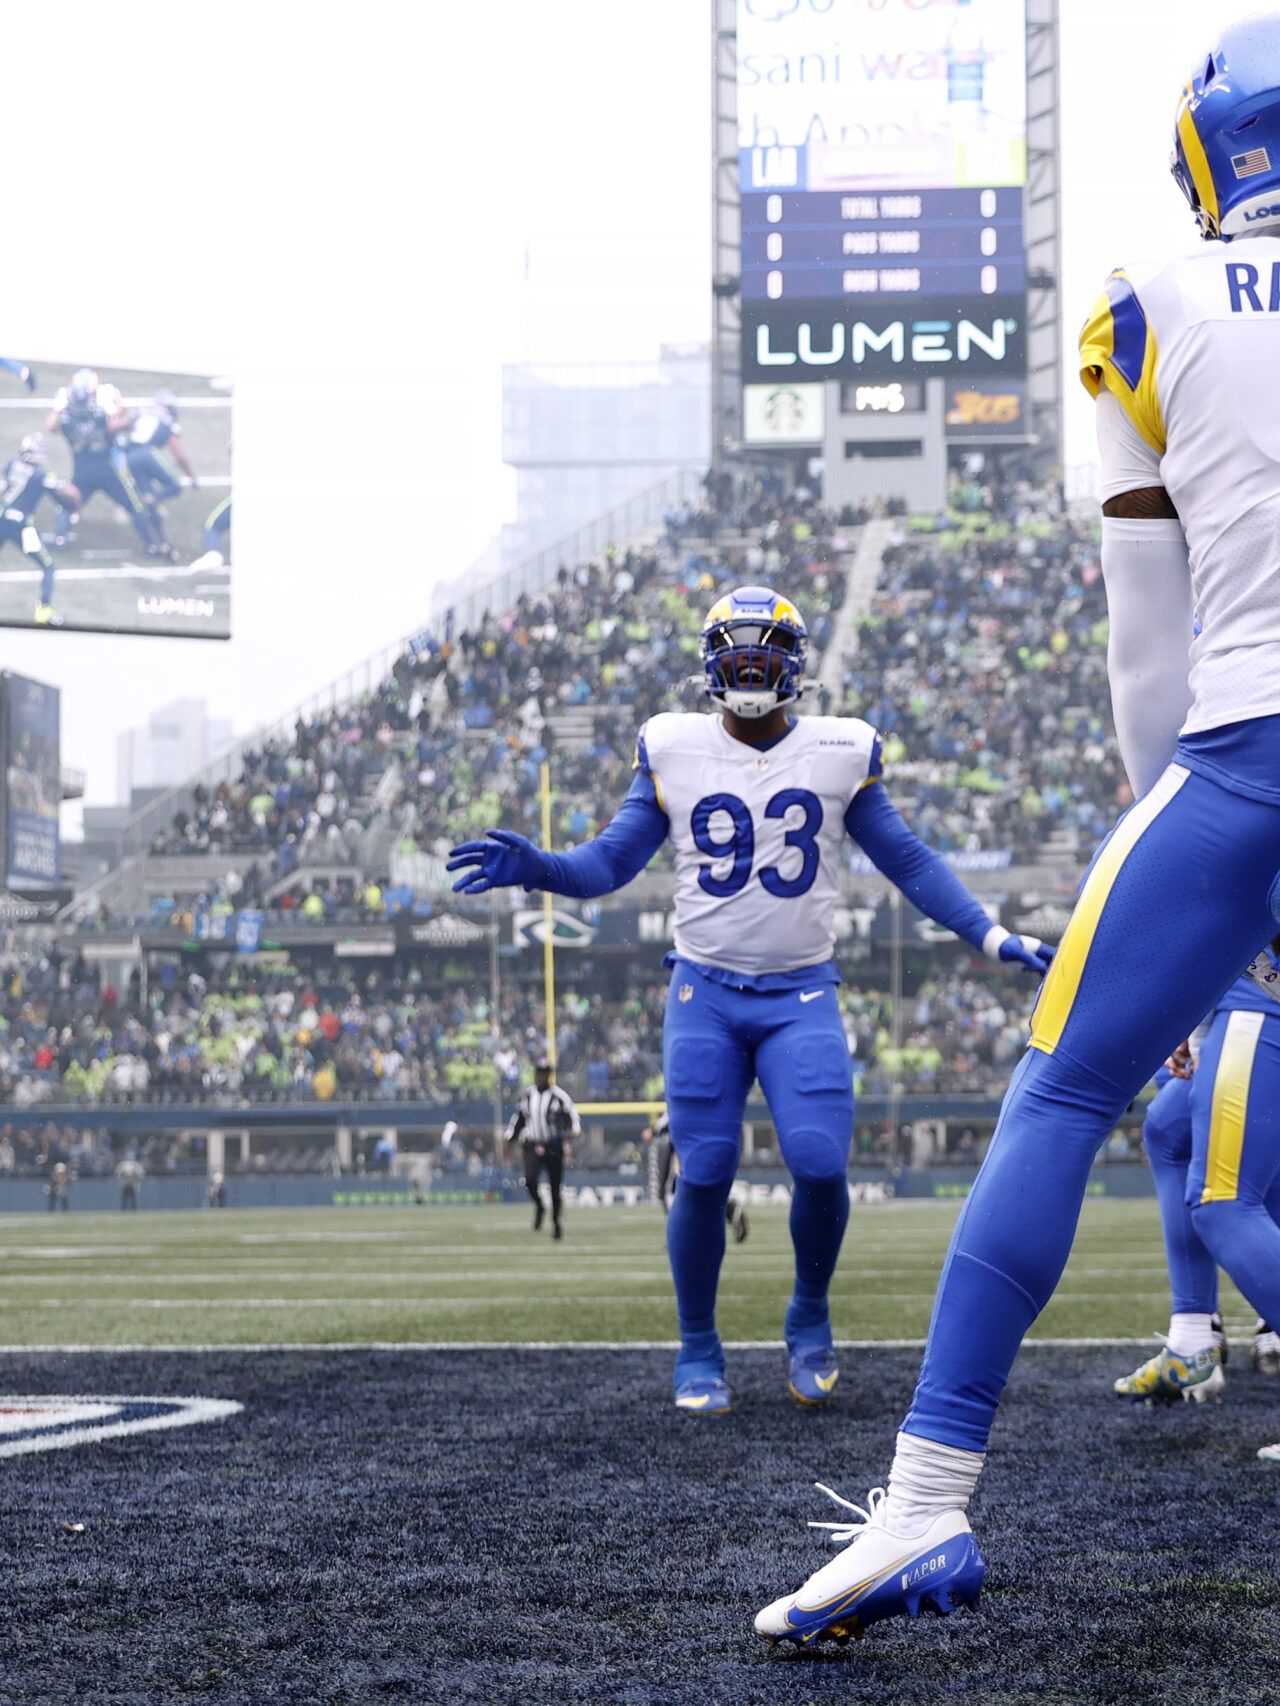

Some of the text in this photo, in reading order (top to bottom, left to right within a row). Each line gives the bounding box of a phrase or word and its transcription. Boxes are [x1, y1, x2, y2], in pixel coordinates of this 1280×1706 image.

[756, 318, 1007, 367] LUMEN
[137, 596, 215, 618] LUMEN
[690, 787, 824, 898] 93
[908, 1554, 946, 1583] VAPOR
